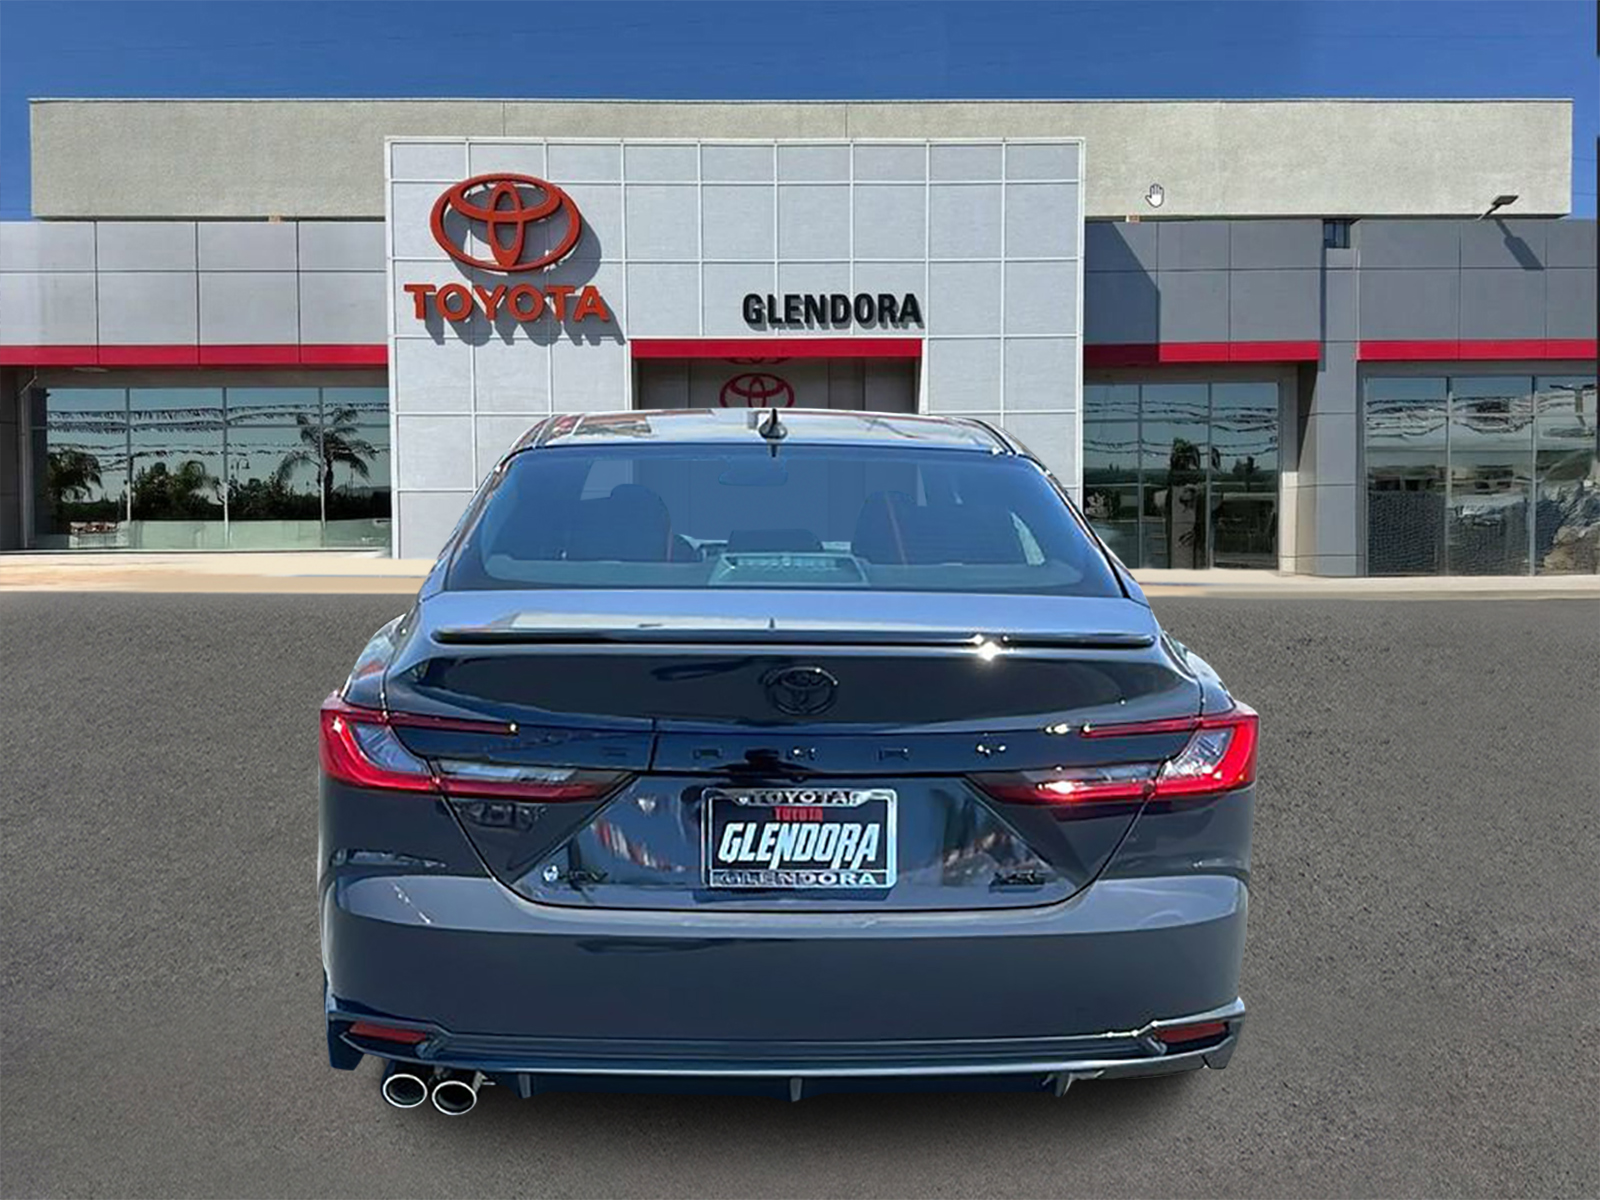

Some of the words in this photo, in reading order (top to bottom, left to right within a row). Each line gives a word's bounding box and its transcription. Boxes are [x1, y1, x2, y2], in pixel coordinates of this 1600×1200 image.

[404, 284, 610, 323] TOYOTA
[743, 293, 922, 325] GLENDORA
[752, 790, 849, 804] TOYOTA
[718, 823, 880, 870] GLENDORA
[720, 873, 876, 885] GLENDORA
